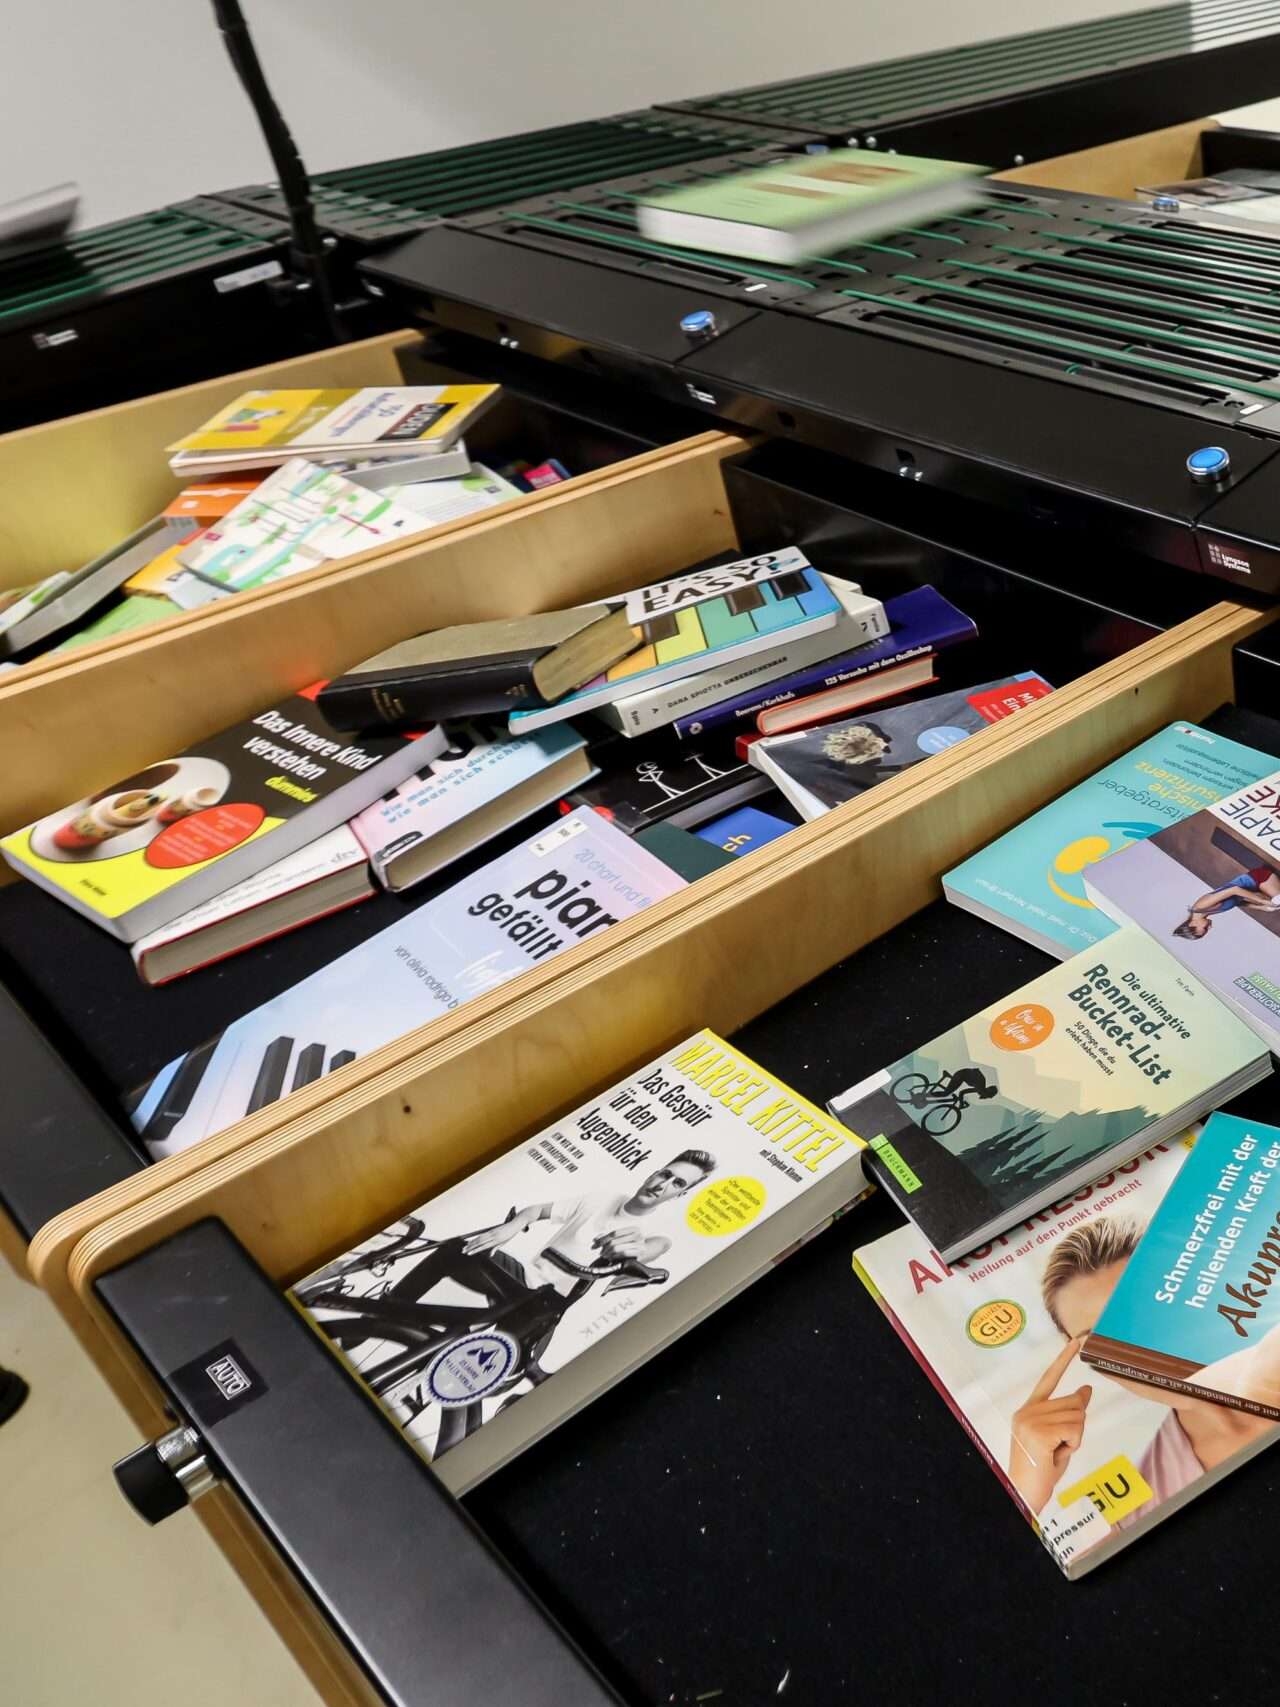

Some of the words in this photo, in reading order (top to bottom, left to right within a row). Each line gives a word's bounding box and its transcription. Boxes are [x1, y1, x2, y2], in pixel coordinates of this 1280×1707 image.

[726, 555, 777, 575] SO
[242, 735, 328, 781] verstehen
[252, 709, 288, 733] Das
[281, 723, 340, 757] Innere
[335, 746, 384, 772] Kind
[467, 892, 565, 961] gefällt
[1082, 962, 1166, 1042] Rennrad-
[1120, 970, 1143, 992] Die
[1138, 987, 1192, 1041] ultimative
[1064, 1026, 1083, 1045] erlebt
[1078, 1039, 1099, 1061] haben
[1067, 982, 1173, 1086] Bucket-List
[1072, 1020, 1083, 1031] 50
[1098, 1044, 1110, 1057] die
[623, 1103, 659, 1132] den
[658, 1083, 714, 1128] Gespür
[669, 1039, 771, 1117] MARCEL
[746, 1096, 846, 1174] KITTEL
[967, 1254, 1015, 1285] Heilung
[1013, 1240, 1036, 1258] auf
[1035, 1227, 1057, 1246] den
[1057, 1207, 1093, 1236] Punkt
[1092, 1178, 1143, 1213] gebracht
[1154, 1193, 1226, 1305] Schmerzfrei
[1216, 1162, 1244, 1193] mit
[1233, 1133, 1260, 1162] der
[1184, 1218, 1248, 1309] heilenden
[1233, 1169, 1273, 1214] Kraft
[579, 1297, 635, 1339] MALIK
[210, 1360, 246, 1395] AUTO
